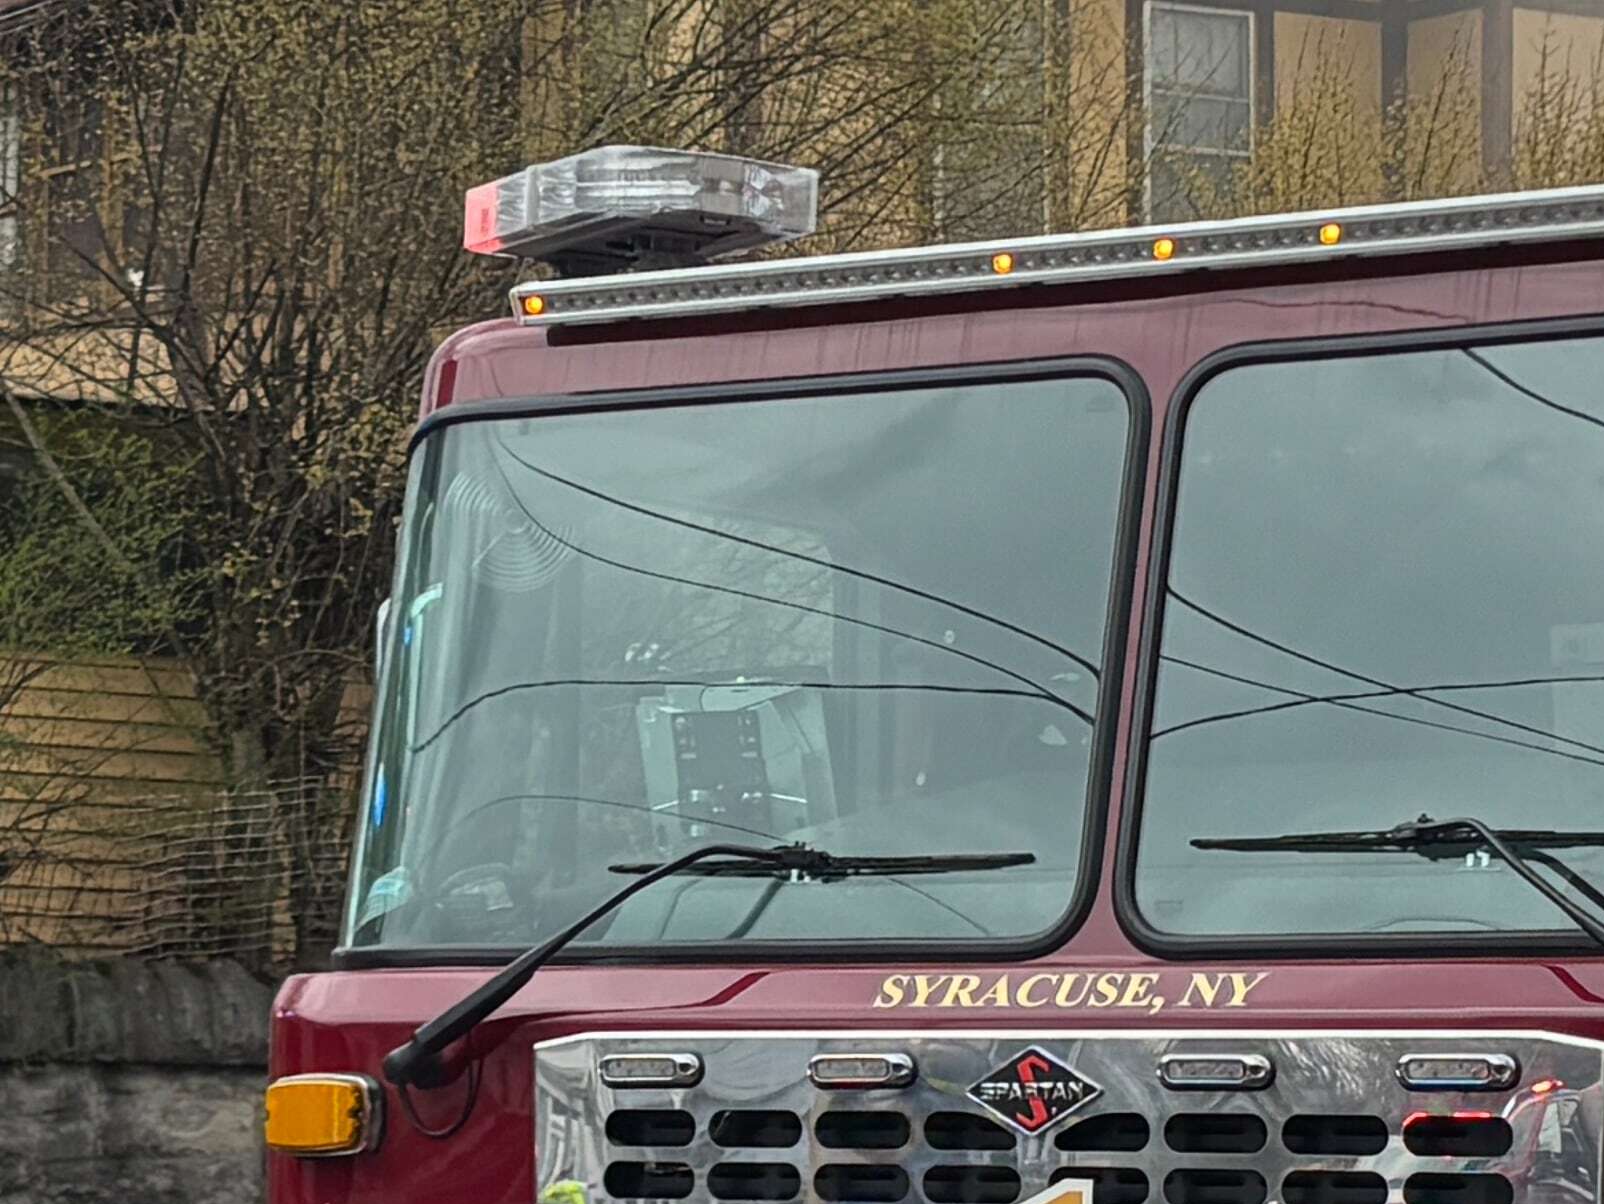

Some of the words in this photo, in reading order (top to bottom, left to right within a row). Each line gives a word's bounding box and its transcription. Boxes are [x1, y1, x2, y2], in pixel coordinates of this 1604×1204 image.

[873, 971, 1166, 1016] SYRACUSE,
[1178, 971, 1270, 1008] NY
[979, 1080, 1084, 1101] SPARTAN
